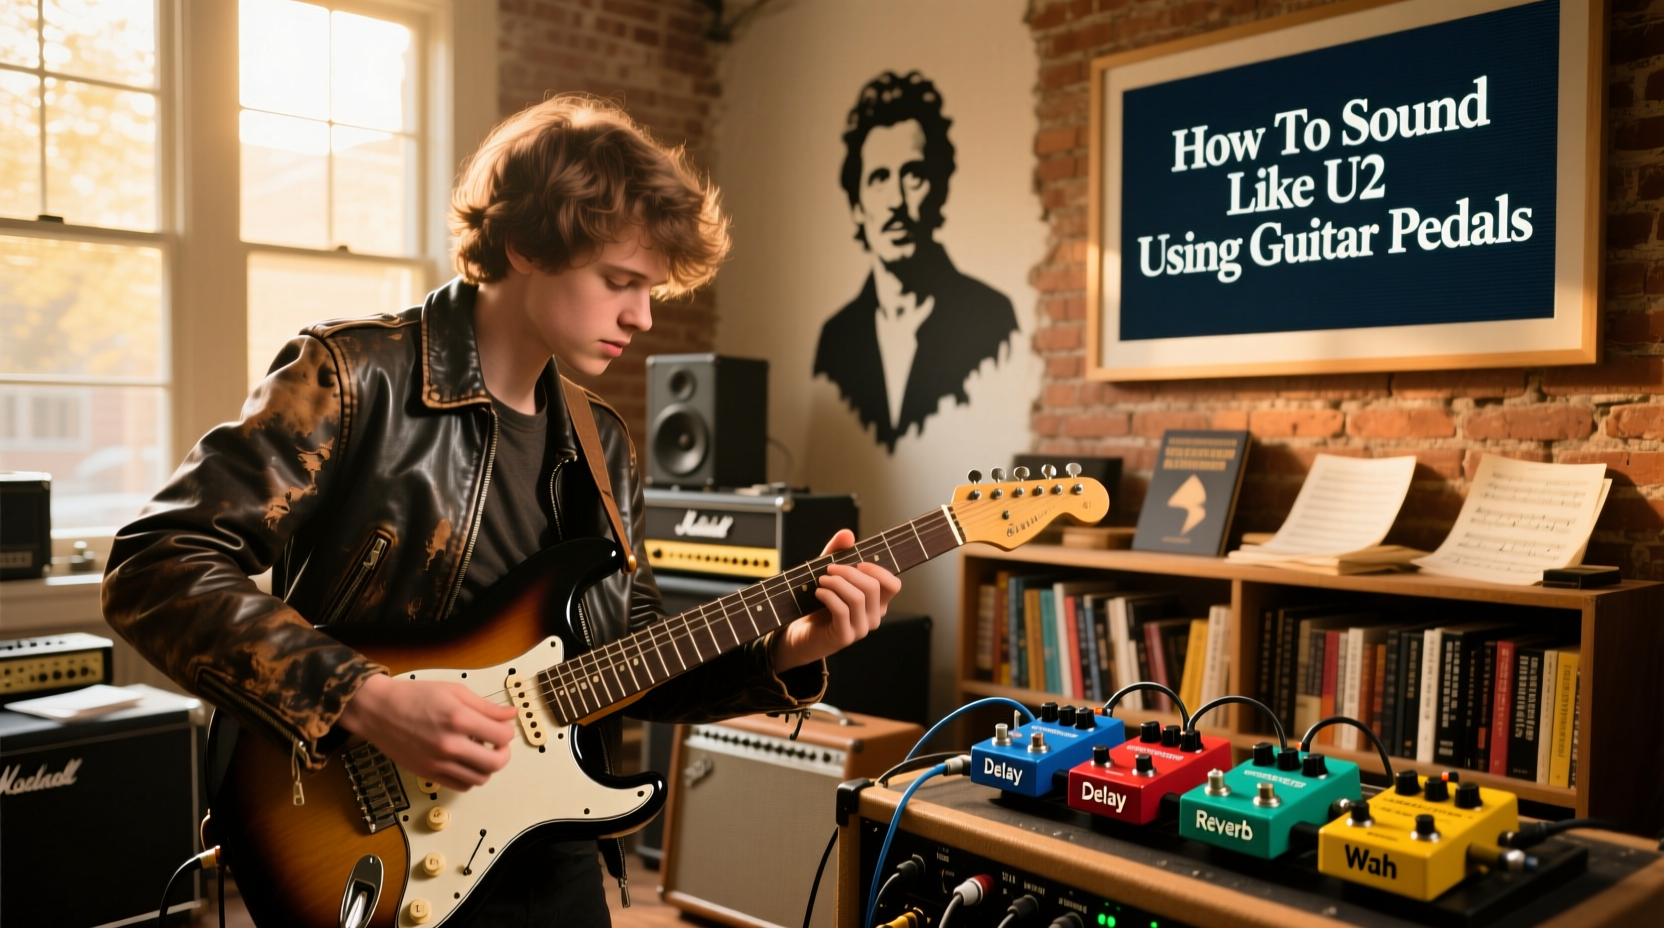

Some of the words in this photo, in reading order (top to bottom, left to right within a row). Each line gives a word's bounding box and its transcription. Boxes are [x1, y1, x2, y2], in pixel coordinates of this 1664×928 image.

[1171, 125, 1266, 173] How
[1274, 108, 1331, 156] To
[1342, 75, 1491, 146] Sound
[1226, 164, 1315, 216] Like
[1323, 153, 1386, 204] U2
[1137, 230, 1244, 284] Using
[1249, 217, 1380, 267] Guitar
[1387, 193, 1534, 254] Pedals
[983, 757, 1024, 787] Delay
[1081, 781, 1127, 813] Delay
[1195, 809, 1254, 841] Reverb
[1344, 843, 1398, 880] Wah
